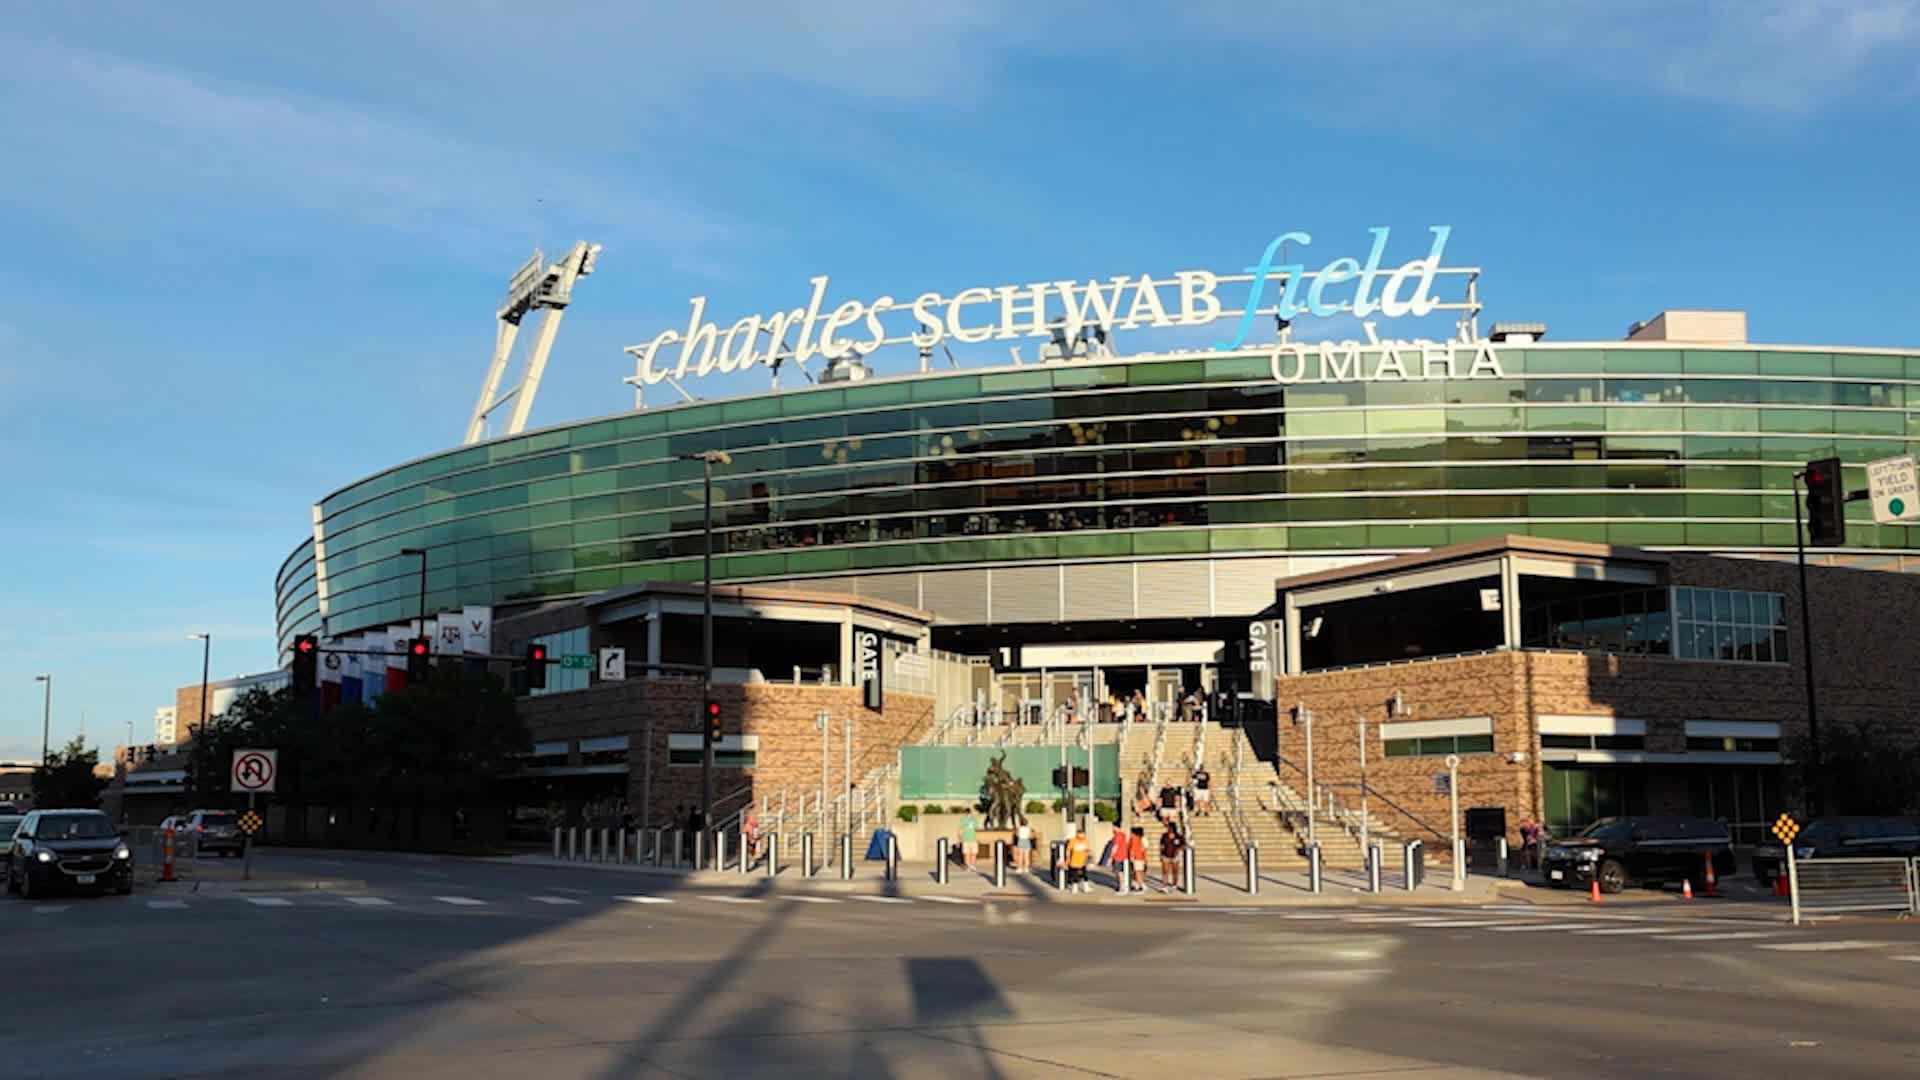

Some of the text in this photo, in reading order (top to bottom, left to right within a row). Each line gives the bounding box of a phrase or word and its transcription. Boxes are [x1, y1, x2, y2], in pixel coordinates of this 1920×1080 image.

[643, 225, 1451, 384] charles SCHWAB field
[1271, 340, 1504, 384] OMAHA
[1876, 471, 1909, 487] YIELD
[862, 632, 878, 681] GATE
[999, 646, 1011, 667] 1
[1249, 621, 1267, 673] GATE
